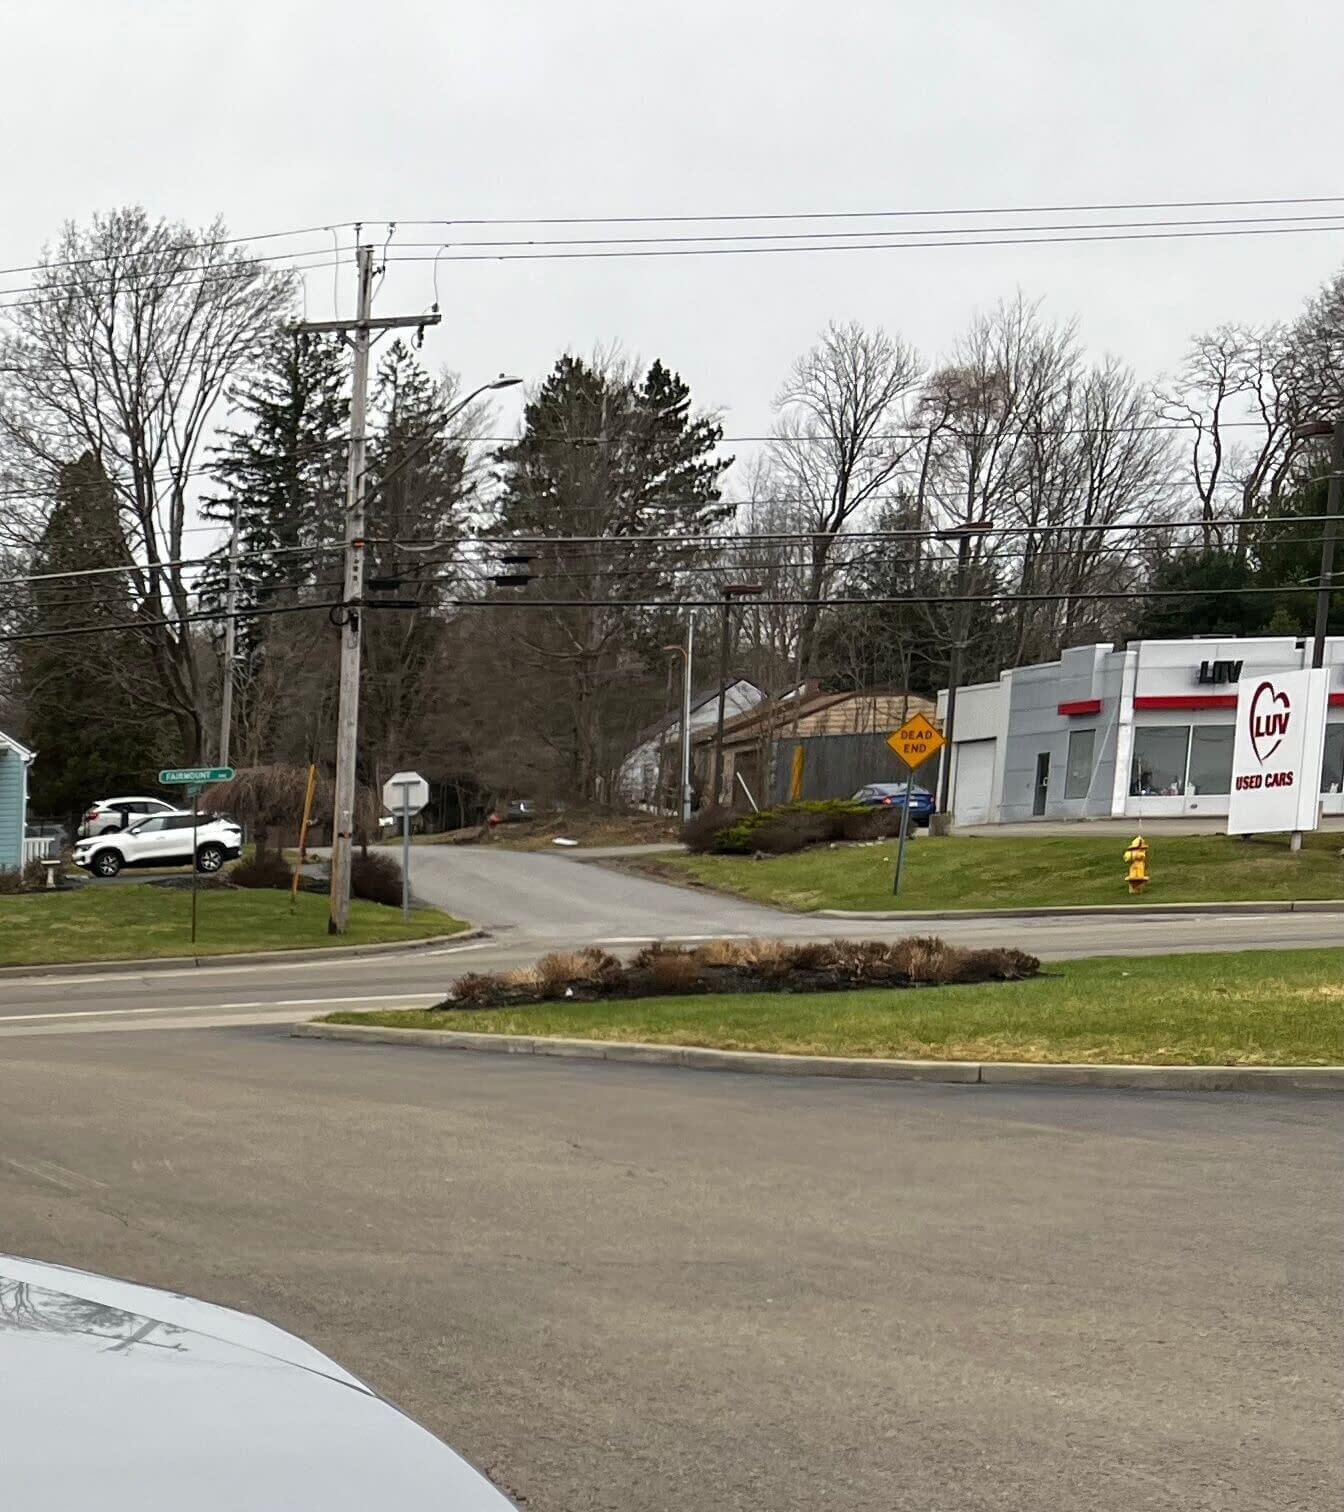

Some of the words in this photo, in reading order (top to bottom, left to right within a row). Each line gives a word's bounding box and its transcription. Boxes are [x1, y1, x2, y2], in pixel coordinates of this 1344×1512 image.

[1255, 712, 1292, 738] LUV
[900, 730, 932, 740] DEAD
[903, 743, 927, 753] END
[165, 771, 211, 781] FAIRMOUNT
[1235, 774, 1262, 791] USED
[1265, 771, 1294, 788] CARS
